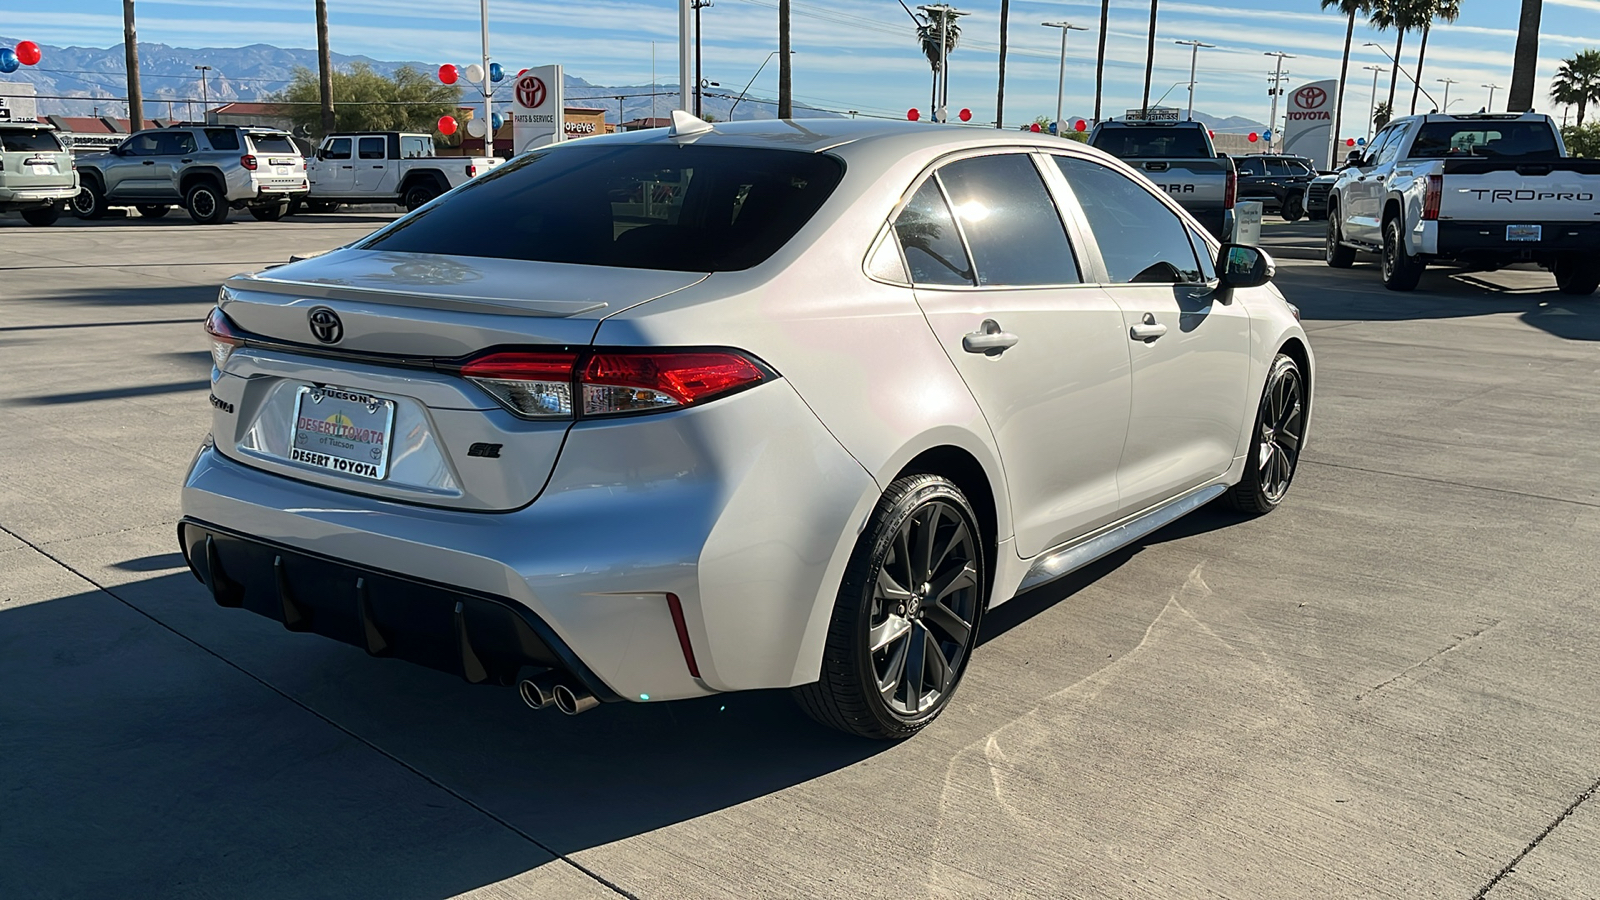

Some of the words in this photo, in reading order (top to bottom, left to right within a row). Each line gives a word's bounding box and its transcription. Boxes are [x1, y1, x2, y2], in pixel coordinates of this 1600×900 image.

[515, 115, 528, 123] PARTS
[528, 115, 533, 123] &
[533, 115, 554, 123] SERVICE
[1287, 111, 1331, 121] TOYOTA
[320, 389, 368, 404] TUCSON
[299, 417, 337, 436] DESERT
[341, 425, 384, 446] TOYOTA
[320, 437, 327, 445] of
[329, 438, 355, 450] Tucson
[292, 449, 330, 468] DESERT
[333, 459, 378, 478] TOYOTA
